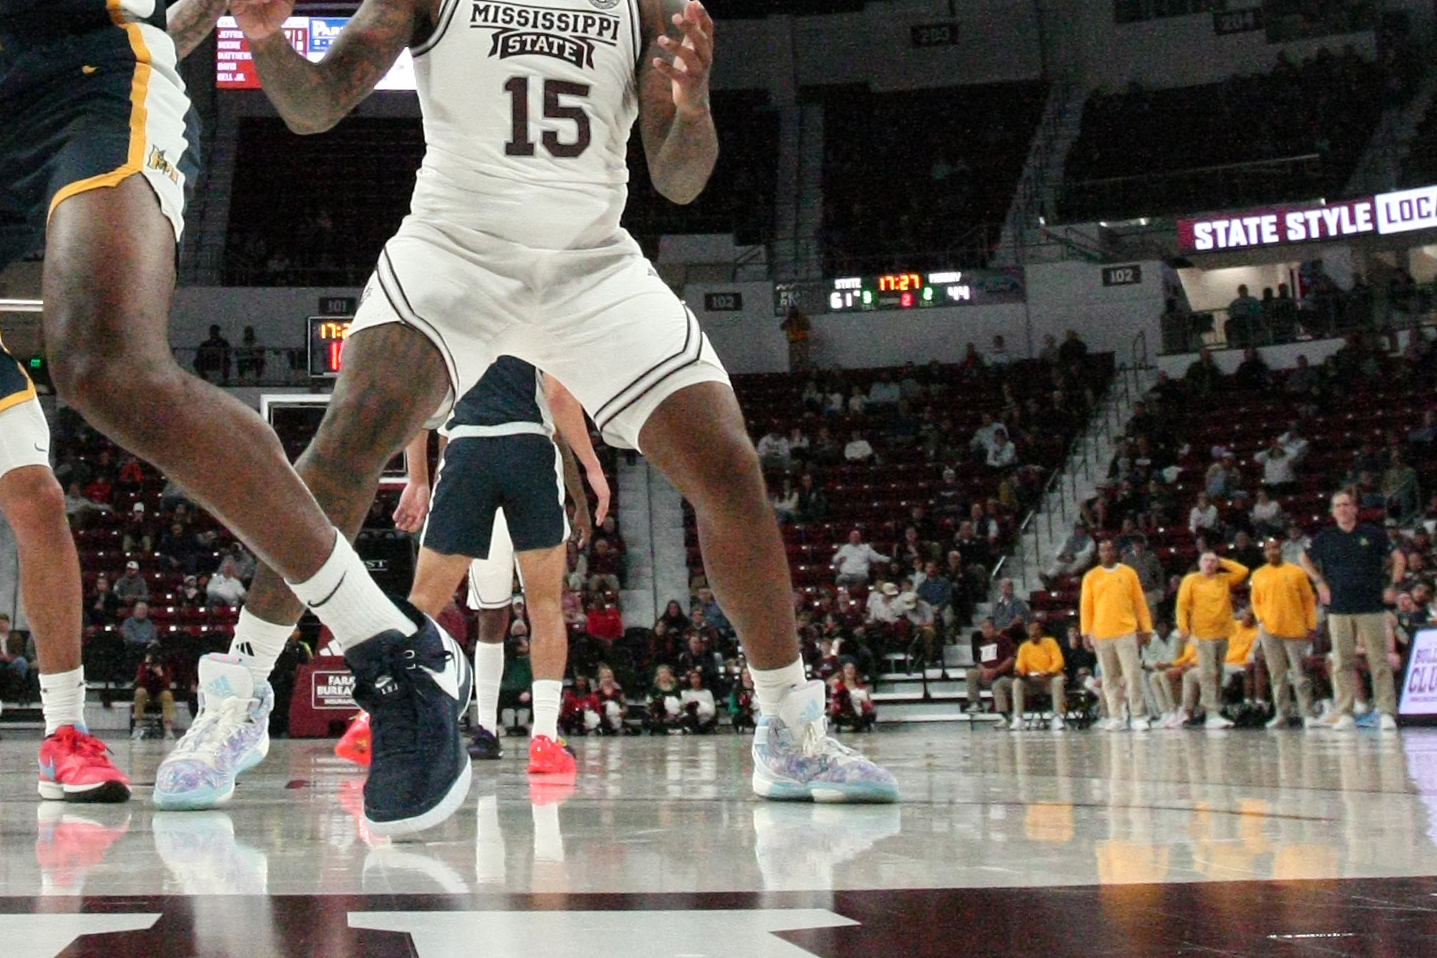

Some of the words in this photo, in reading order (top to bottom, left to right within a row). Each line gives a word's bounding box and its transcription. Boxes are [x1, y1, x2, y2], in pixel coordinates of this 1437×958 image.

[469, 3, 621, 41] MISSISSIPPI
[507, 35, 578, 61] STATE
[503, 76, 592, 158] 15
[1194, 214, 1280, 250] STATE
[1285, 202, 1374, 241] STYLE
[1385, 196, 1437, 224] LOC
[878, 274, 920, 291] 17:27
[1109, 270, 1134, 284] 102
[320, 322, 351, 339] 17:2
[316, 685, 356, 696] BUREA
